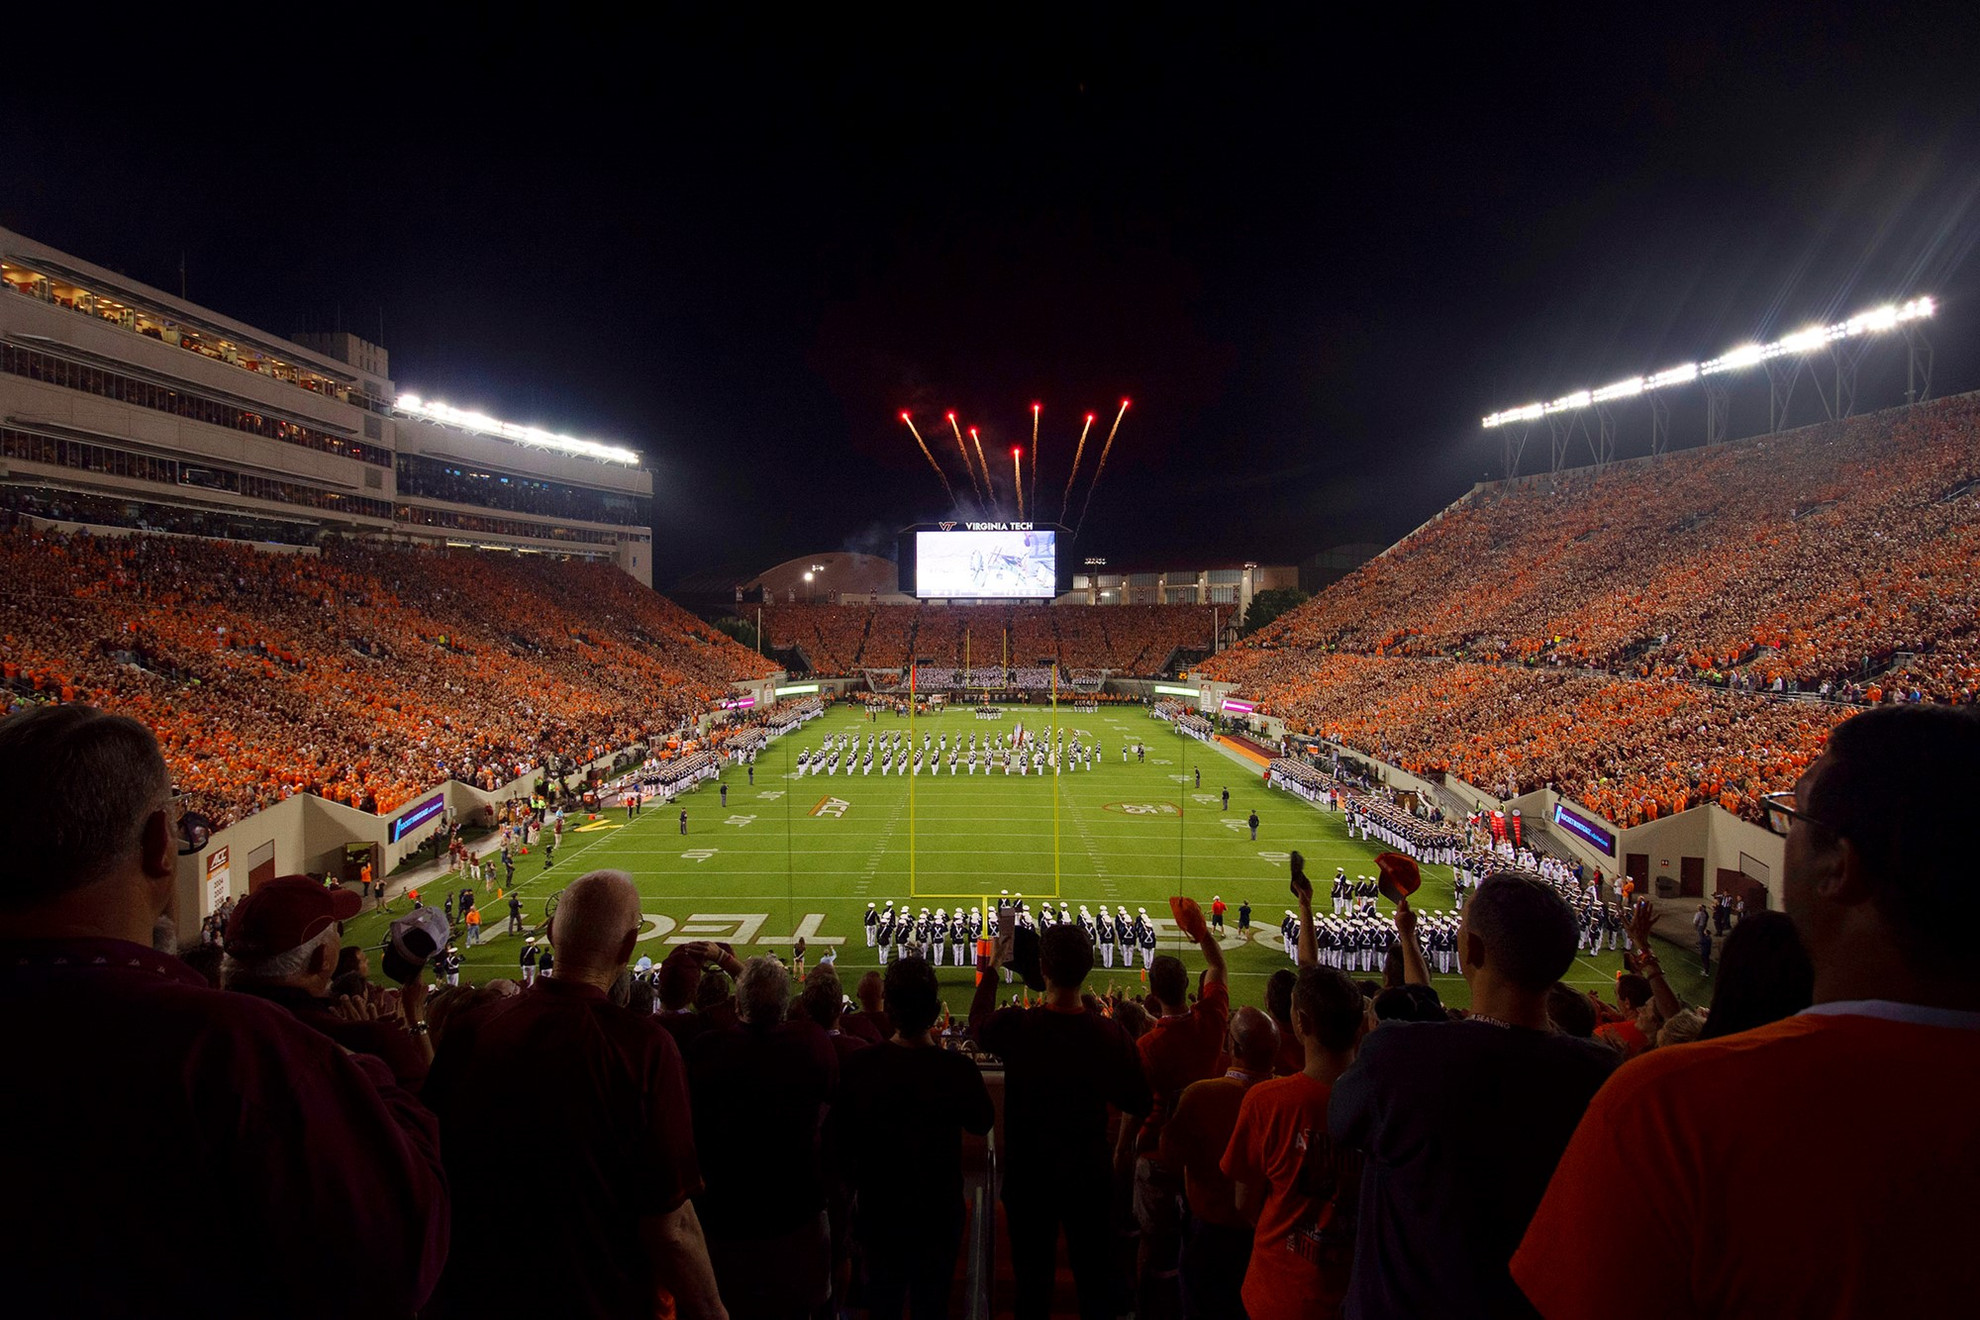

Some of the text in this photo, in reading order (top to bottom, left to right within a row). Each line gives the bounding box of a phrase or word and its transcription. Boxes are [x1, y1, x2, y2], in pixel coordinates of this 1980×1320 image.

[938, 521, 957, 532] VT
[965, 522, 1033, 531] VIRGINIA TECH
[815, 796, 851, 818] ACC
[211, 848, 227, 867] ACC
[680, 848, 719, 859] 10
[1475, 1014, 1510, 1029] SEATING
